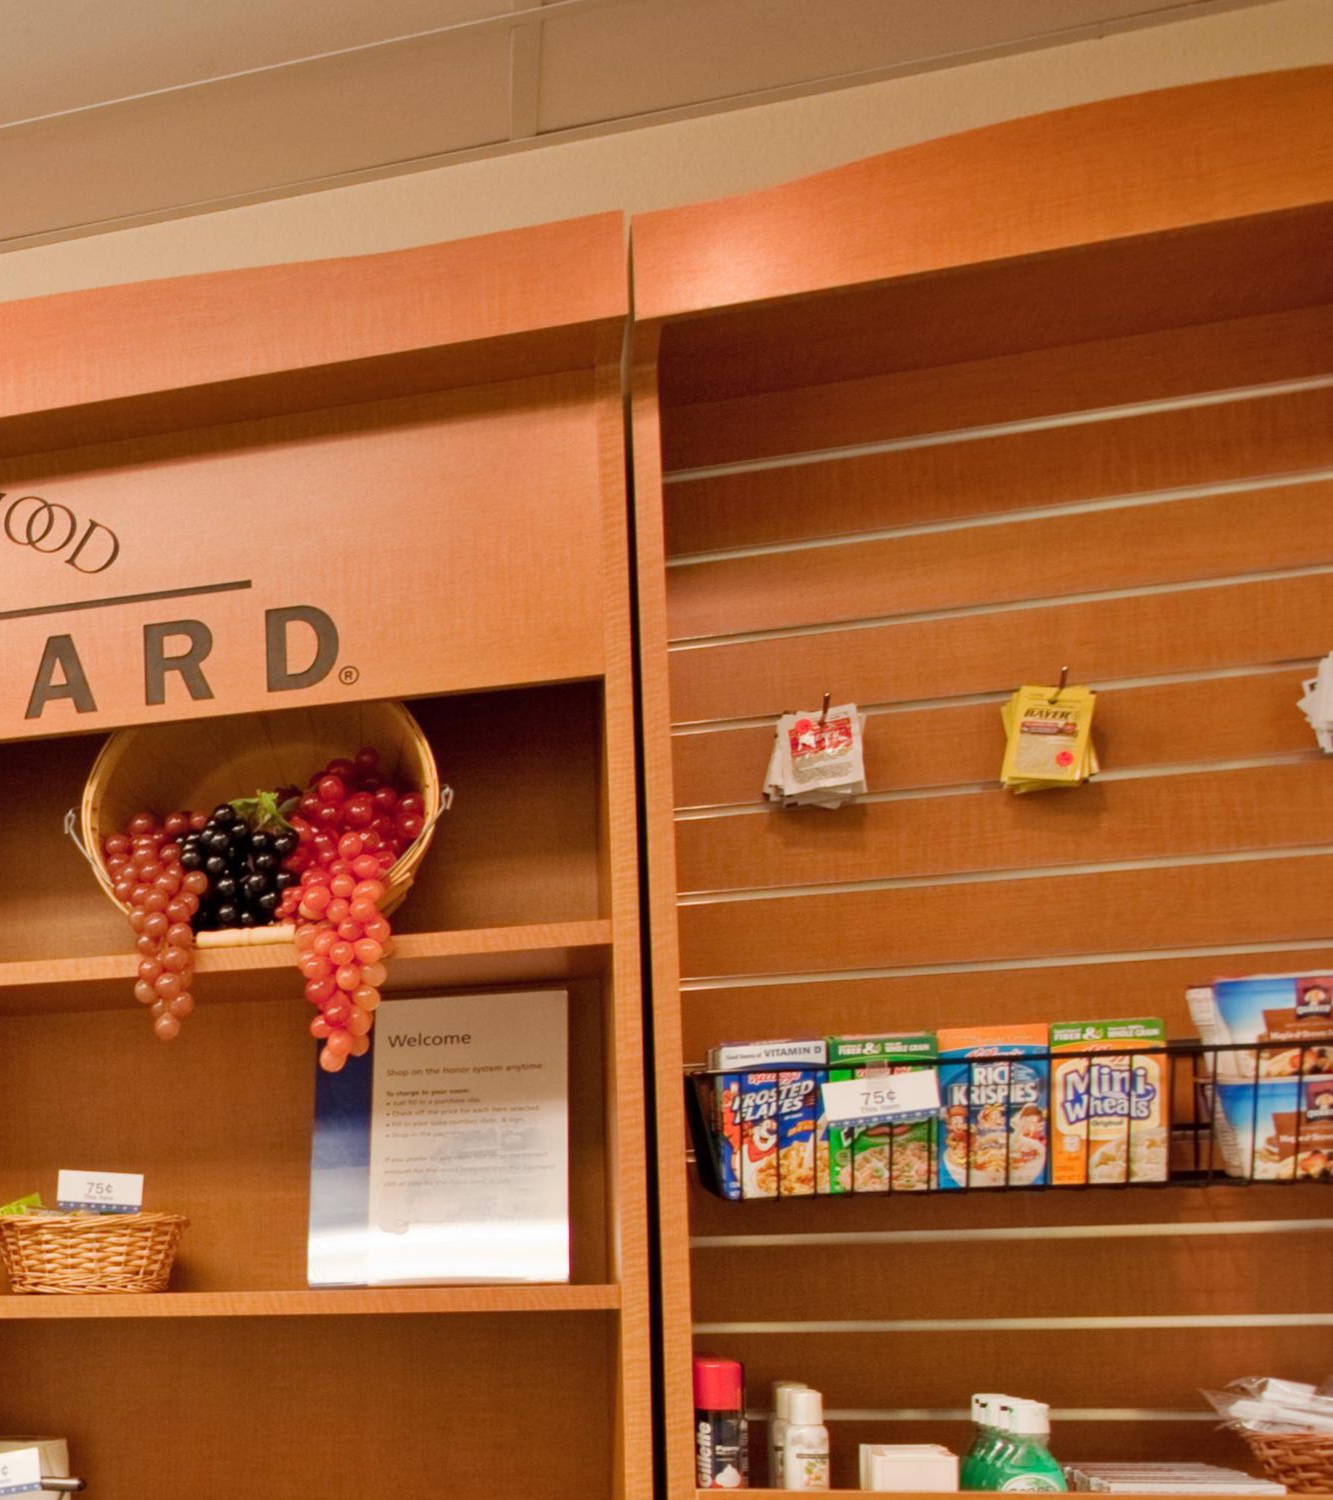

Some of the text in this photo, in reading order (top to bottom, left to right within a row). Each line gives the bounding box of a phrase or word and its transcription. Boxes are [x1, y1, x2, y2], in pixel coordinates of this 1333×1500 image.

[1024, 708, 1071, 719] BAYER
[388, 1032, 472, 1048] Welcome
[764, 1045, 822, 1058] VITAMIN D
[386, 1069, 409, 1078] Shop
[425, 1067, 440, 1075] the
[443, 1067, 470, 1075] honor
[472, 1064, 503, 1074] system
[1066, 1065, 1148, 1101] Mini
[860, 1090, 897, 1105] 75¢
[951, 1081, 1039, 1105] KRISPIES
[1064, 1095, 1150, 1124] Wheats
[86, 1181, 114, 1195] 75¢
[696, 1421, 713, 1488] Gillette
